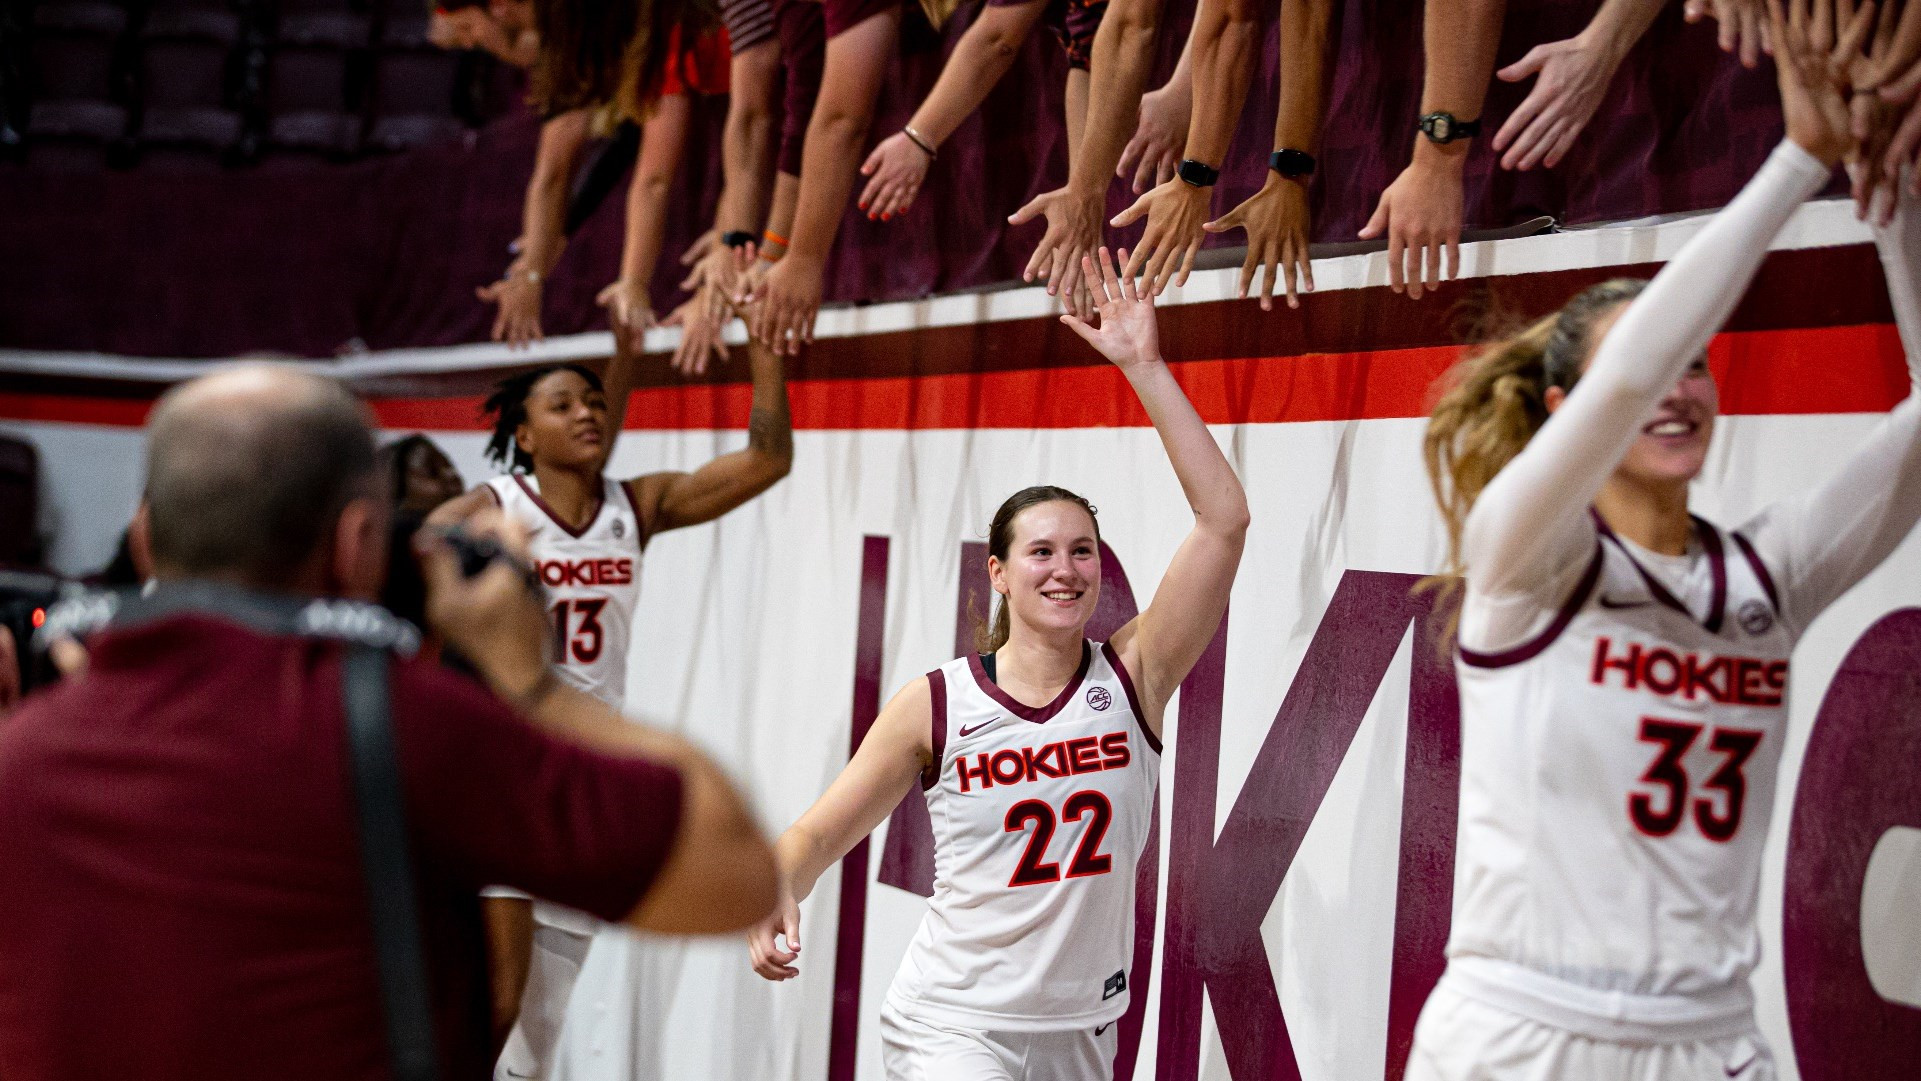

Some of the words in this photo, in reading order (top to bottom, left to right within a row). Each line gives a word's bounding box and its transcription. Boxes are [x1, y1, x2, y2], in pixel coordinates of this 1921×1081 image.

[552, 598, 608, 665] 13
[1590, 637, 1788, 706] HOKIES
[956, 731, 1131, 793] HOKIES
[1627, 715, 1765, 843] 33
[1004, 789, 1113, 888] 22
